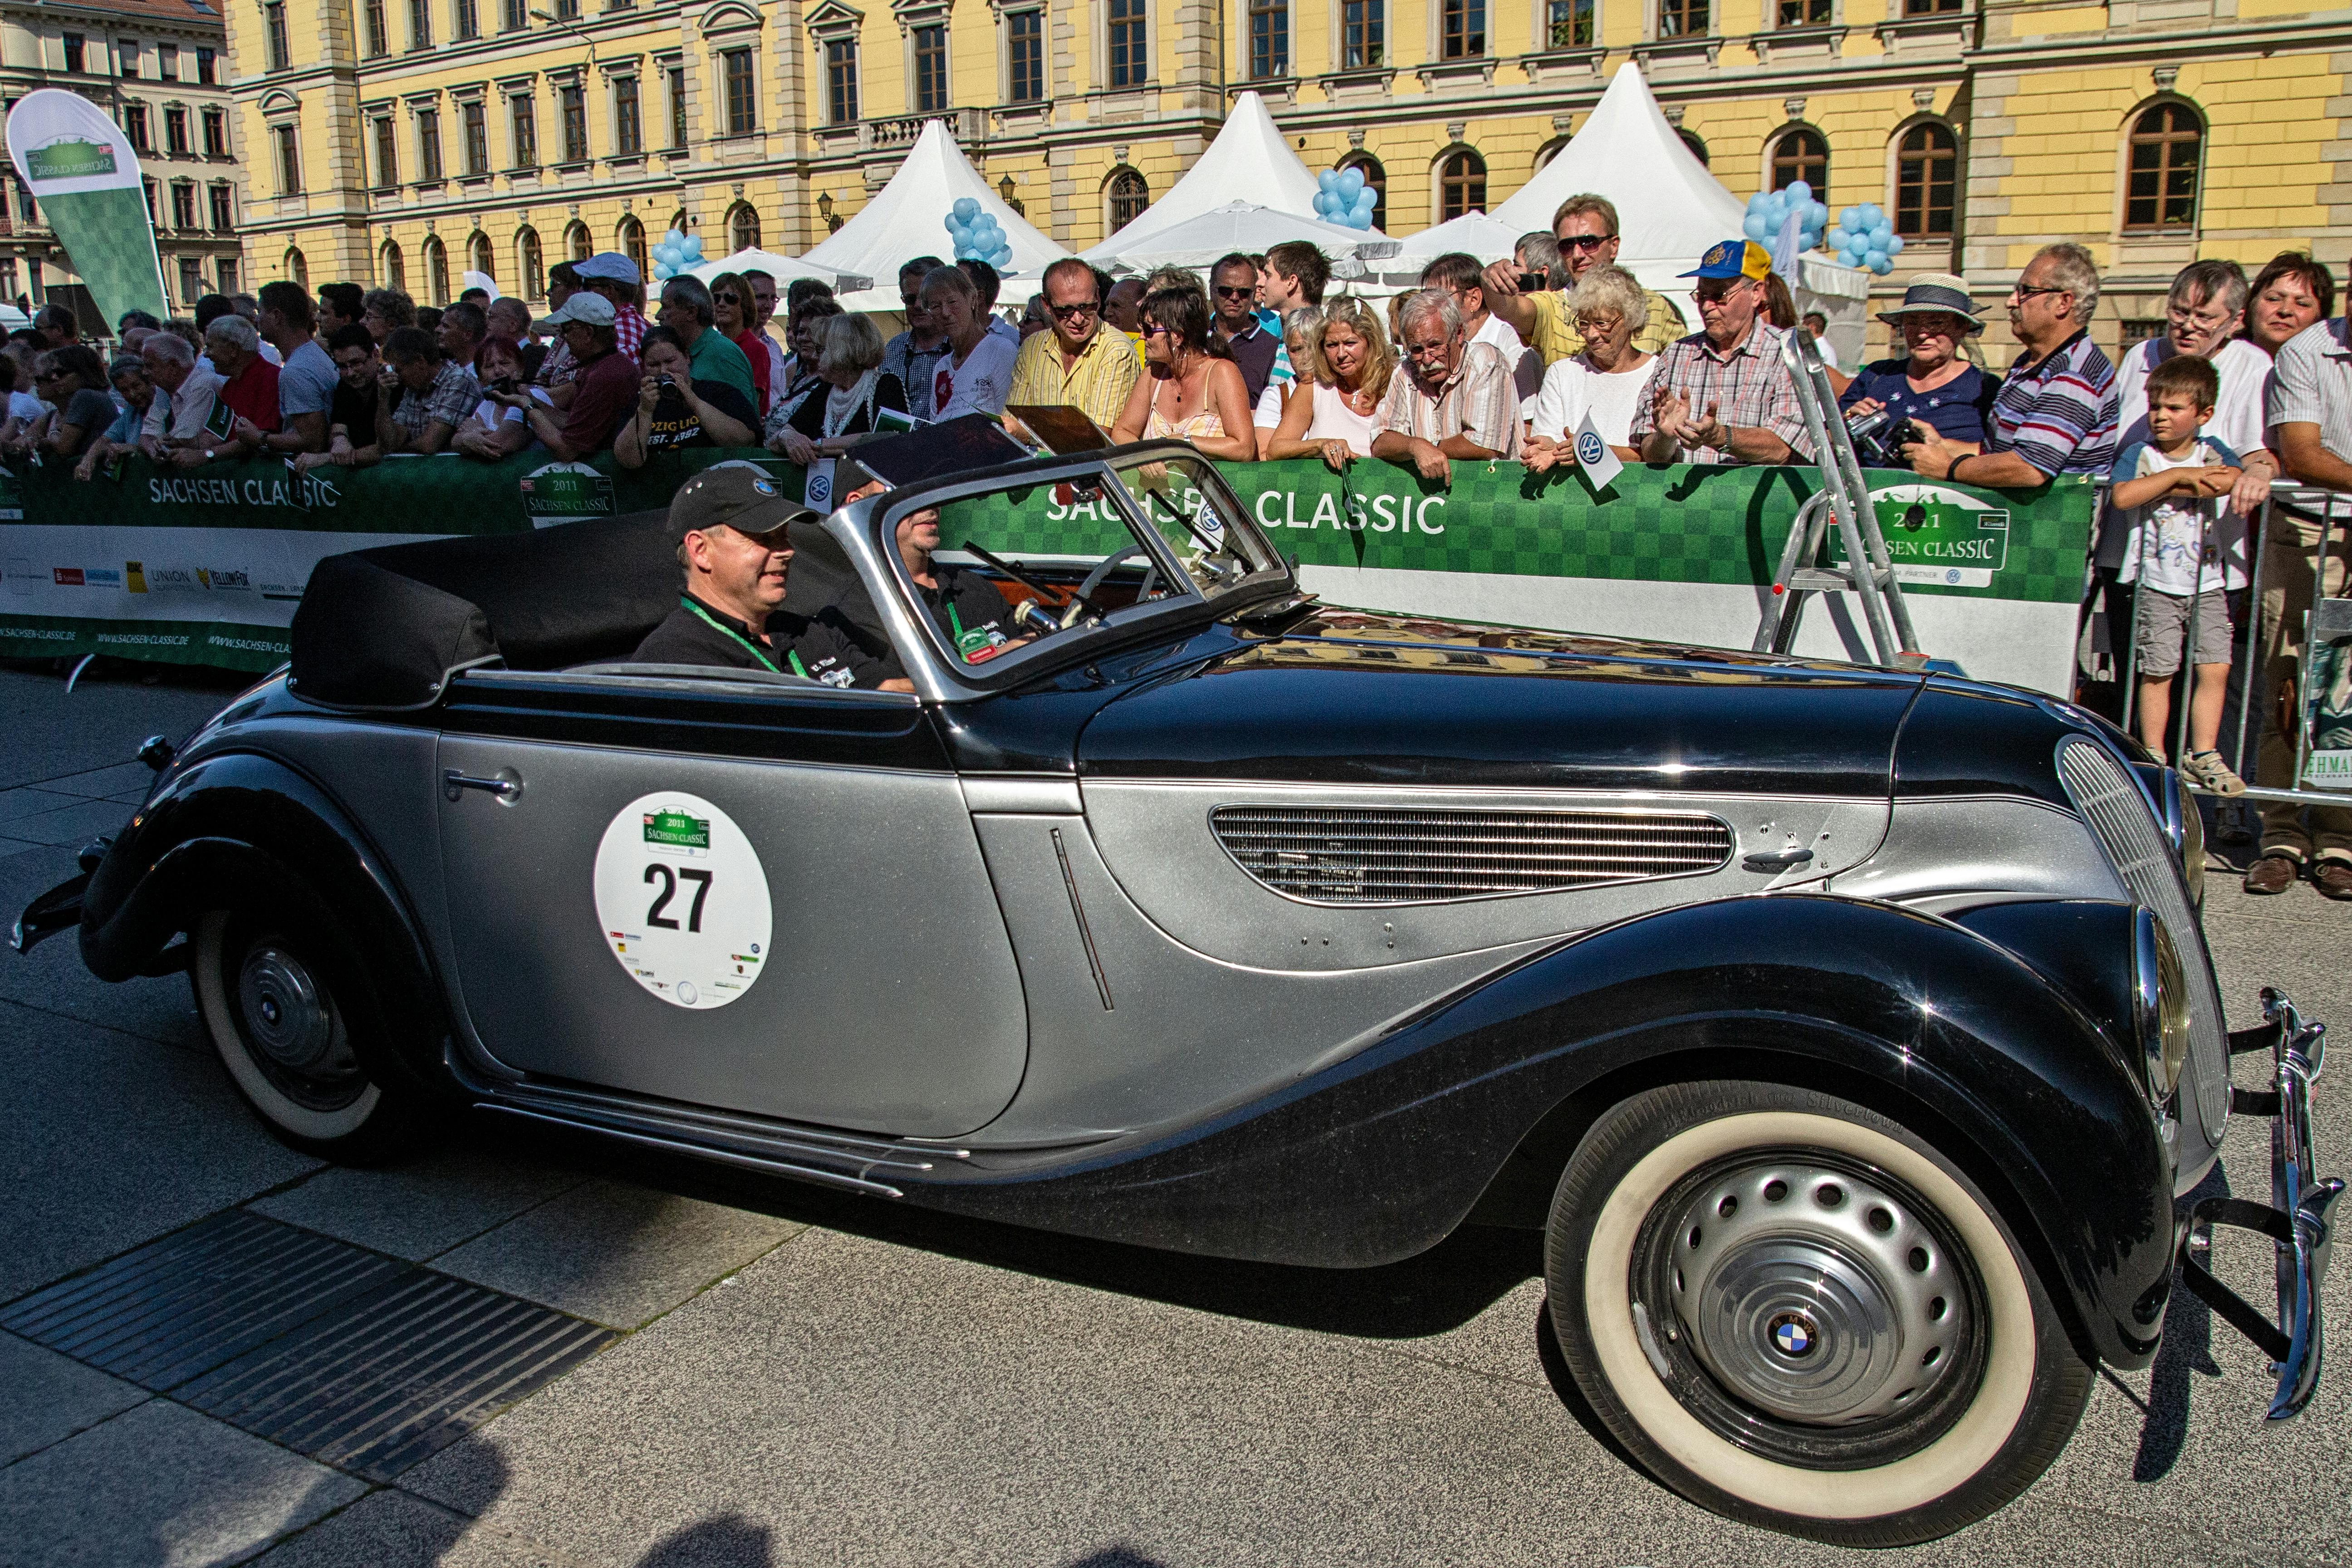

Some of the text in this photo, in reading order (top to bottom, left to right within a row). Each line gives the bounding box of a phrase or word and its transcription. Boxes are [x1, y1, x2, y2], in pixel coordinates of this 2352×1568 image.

[679, 415, 700, 429] LIO
[149, 478, 337, 506] SACHSEN CLASIC
[553, 480, 578, 491] 2011
[529, 496, 610, 511] SACHSEN CLASSIC
[1255, 490, 1446, 534] CLASSIC
[1923, 538, 1995, 559] CLASSIC
[152, 570, 191, 583] UNION
[208, 635, 292, 653] WWW.SACHSEN-CLA
[667, 818, 686, 828] 2011
[647, 828, 706, 845] SACHSEN CLASSIC
[644, 863, 714, 933] 27
[1807, 1091, 1904, 1134] Silvertown
[1773, 1315, 1814, 1334] BMW
